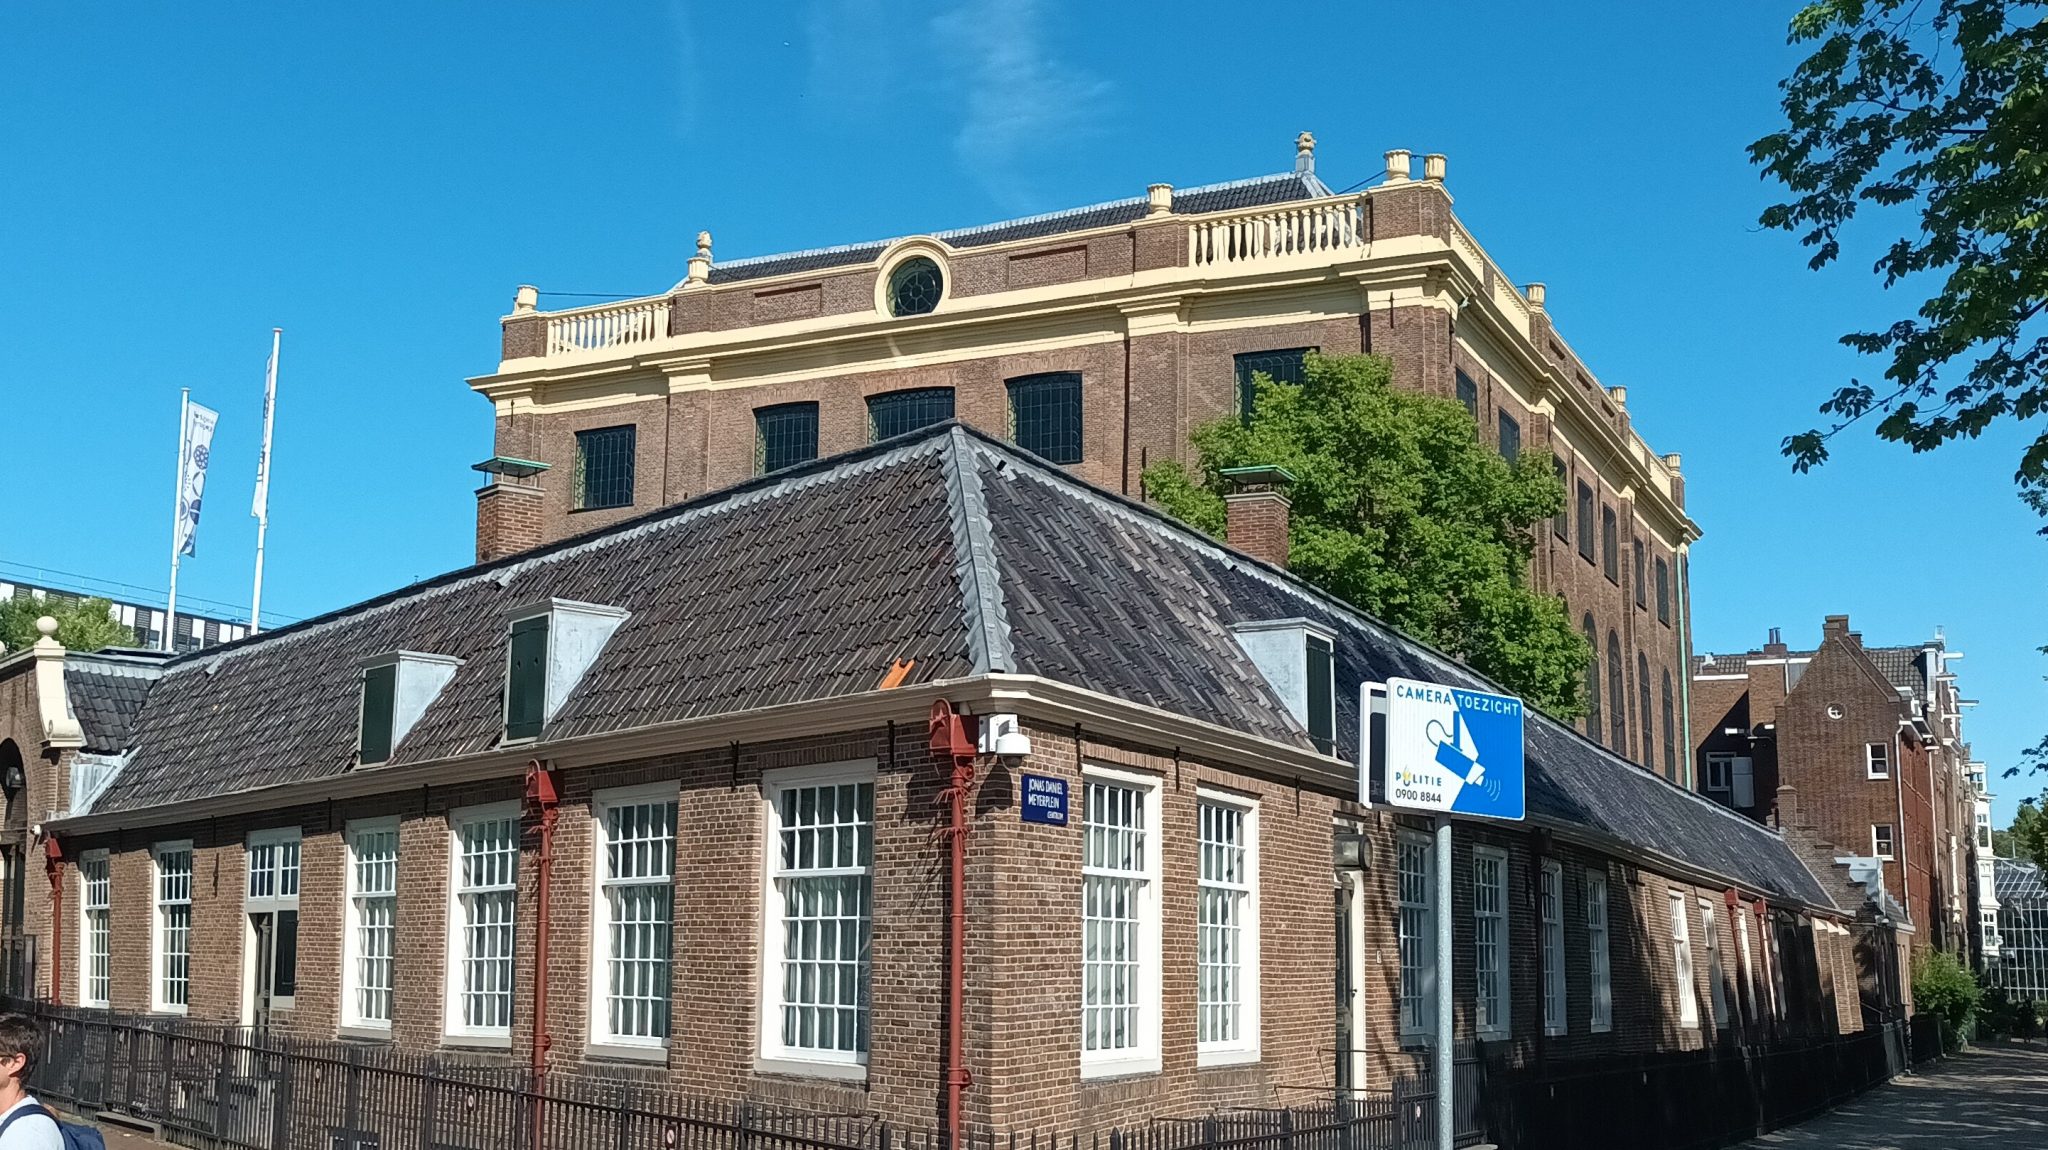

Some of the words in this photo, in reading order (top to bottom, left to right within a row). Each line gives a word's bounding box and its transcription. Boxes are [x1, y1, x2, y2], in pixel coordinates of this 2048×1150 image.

[1397, 685, 1452, 705] CAMERA
[1457, 694, 1518, 716] TOEZICHT
[1028, 778, 1045, 792] JONAS
[1045, 780, 1063, 795] DANIEL
[1396, 788, 1418, 800] 0900
[1420, 790, 1442, 803] 8844
